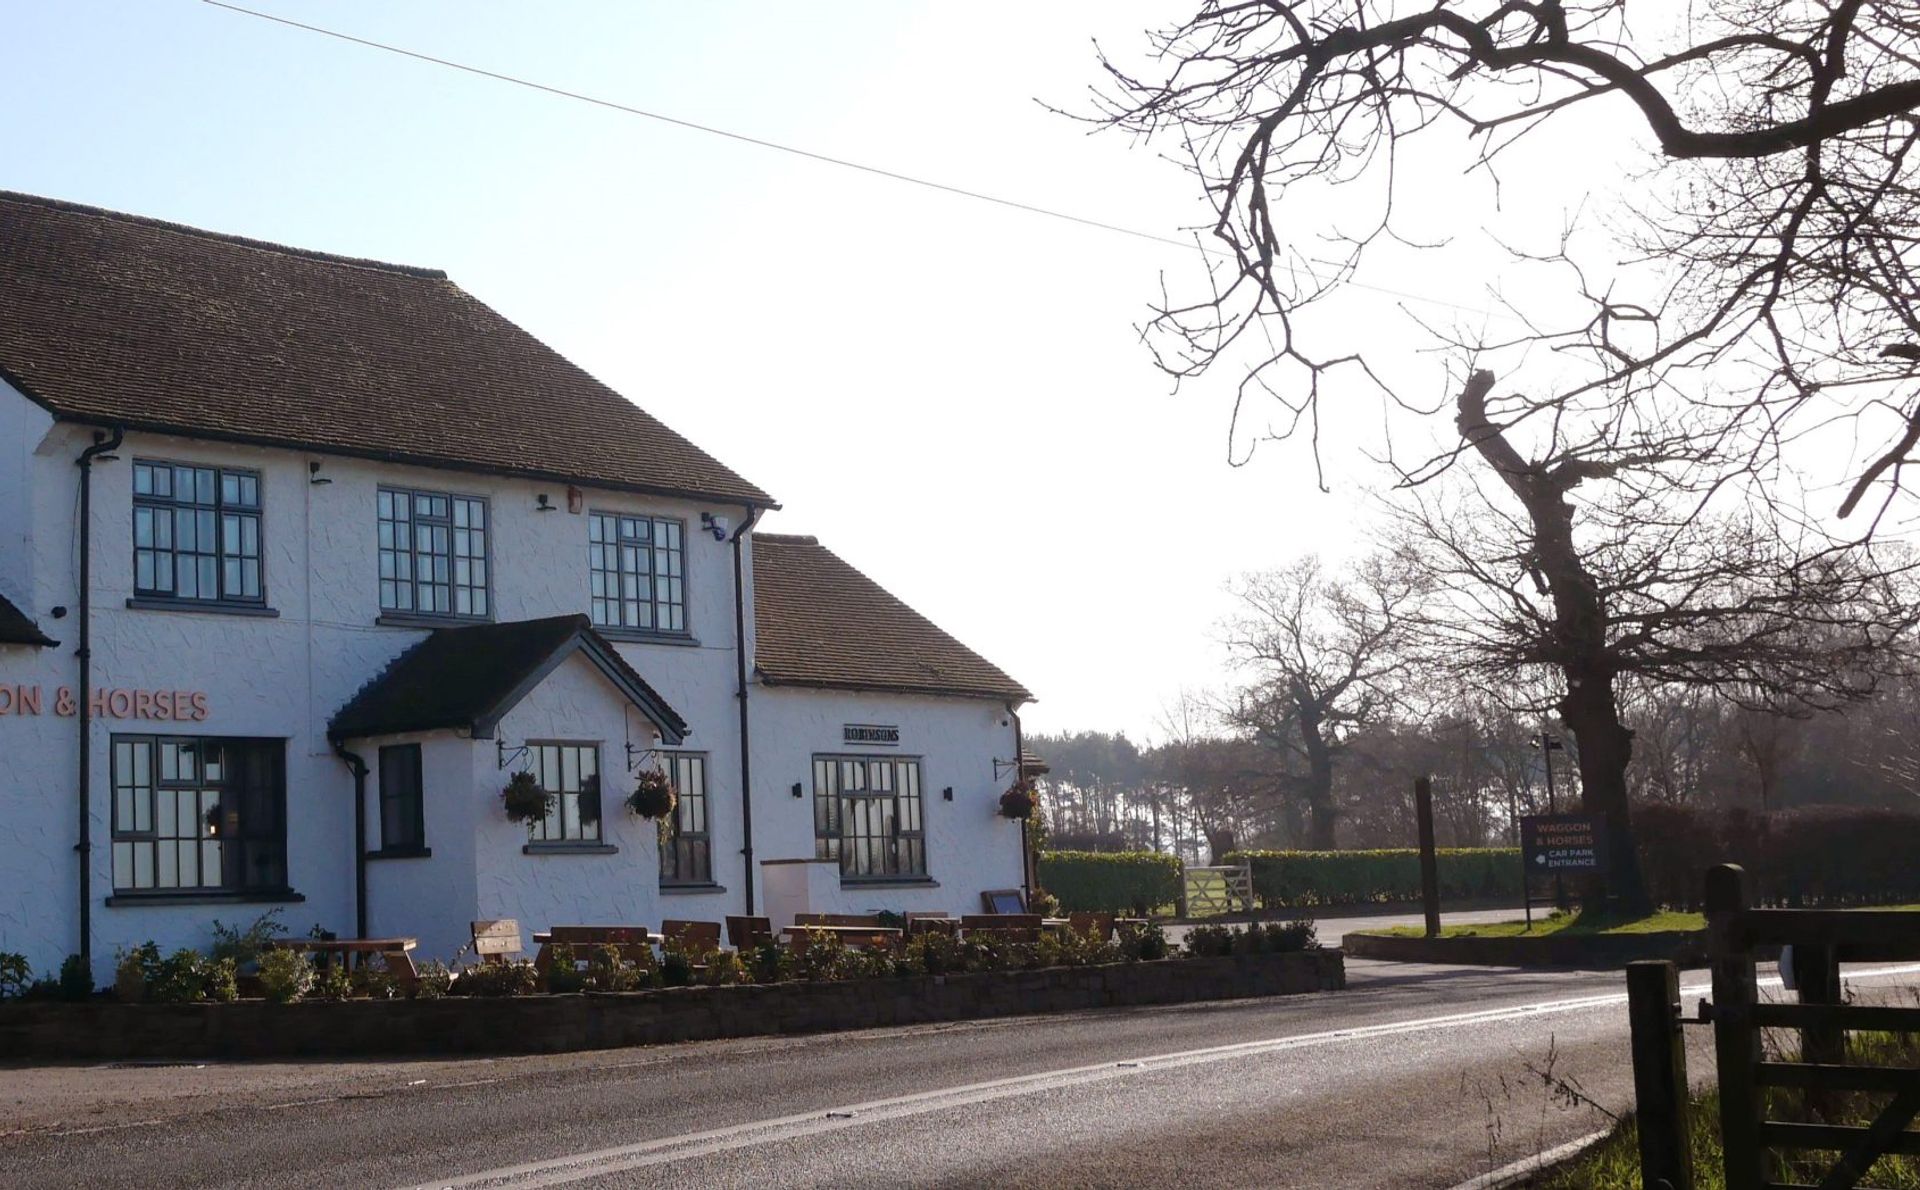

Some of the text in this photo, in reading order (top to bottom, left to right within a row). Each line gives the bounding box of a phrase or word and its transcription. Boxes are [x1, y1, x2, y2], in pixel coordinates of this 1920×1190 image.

[56, 687, 76, 717] &
[89, 687, 209, 721] HORSES
[1537, 823, 1591, 833] WAGGON
[1547, 835, 1593, 846] HORSES
[1548, 849, 1594, 858] CAR PARK
[1548, 858, 1597, 868] ENTRANCE
